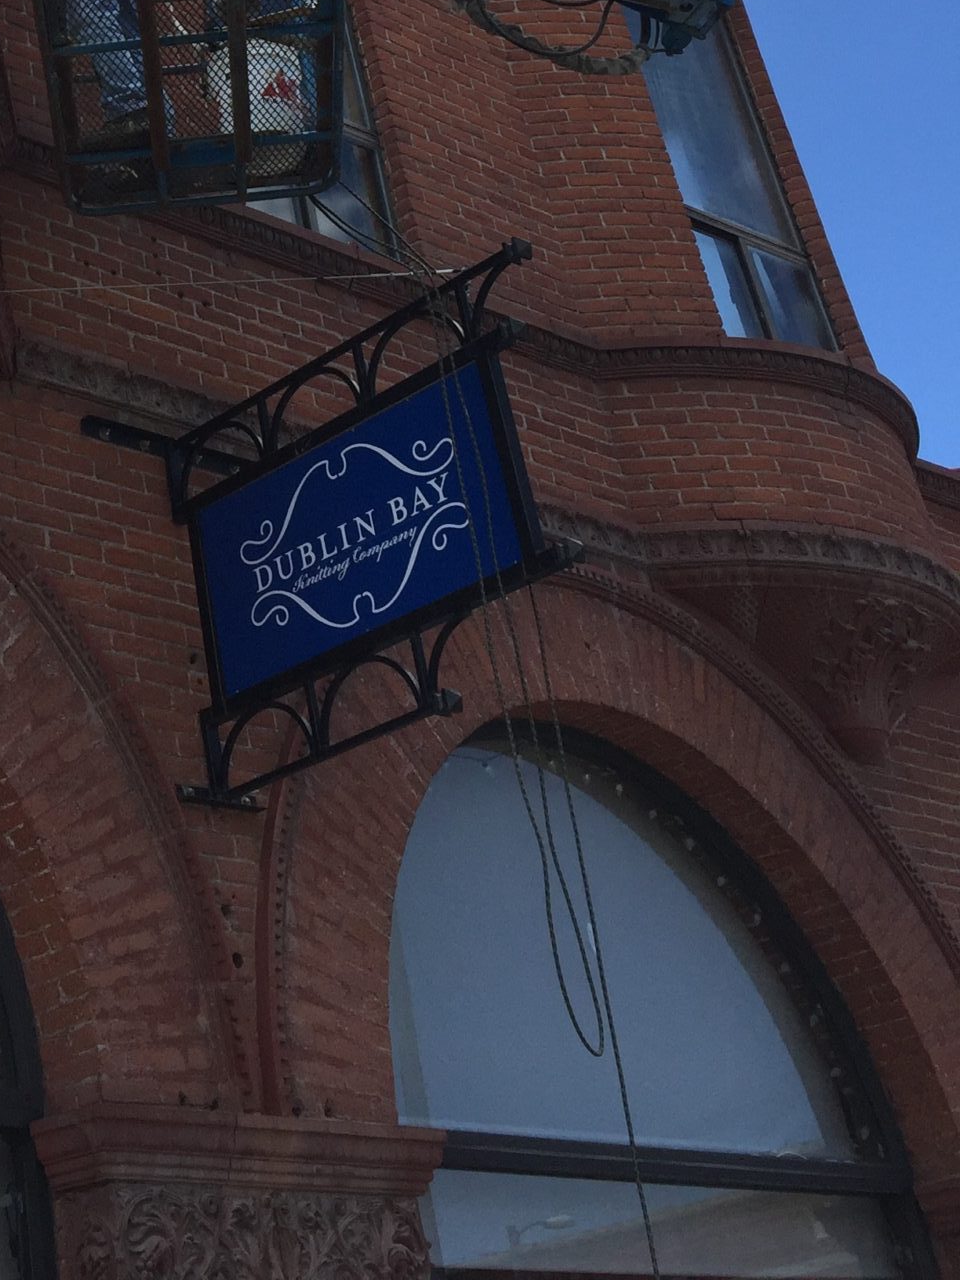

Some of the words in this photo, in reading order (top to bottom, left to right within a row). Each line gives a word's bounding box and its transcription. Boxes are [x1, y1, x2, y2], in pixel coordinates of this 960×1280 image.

[253, 508, 376, 593] DUBLIN
[387, 472, 449, 526] BAY
[292, 556, 351, 593] Knitting
[353, 526, 418, 563] Company
